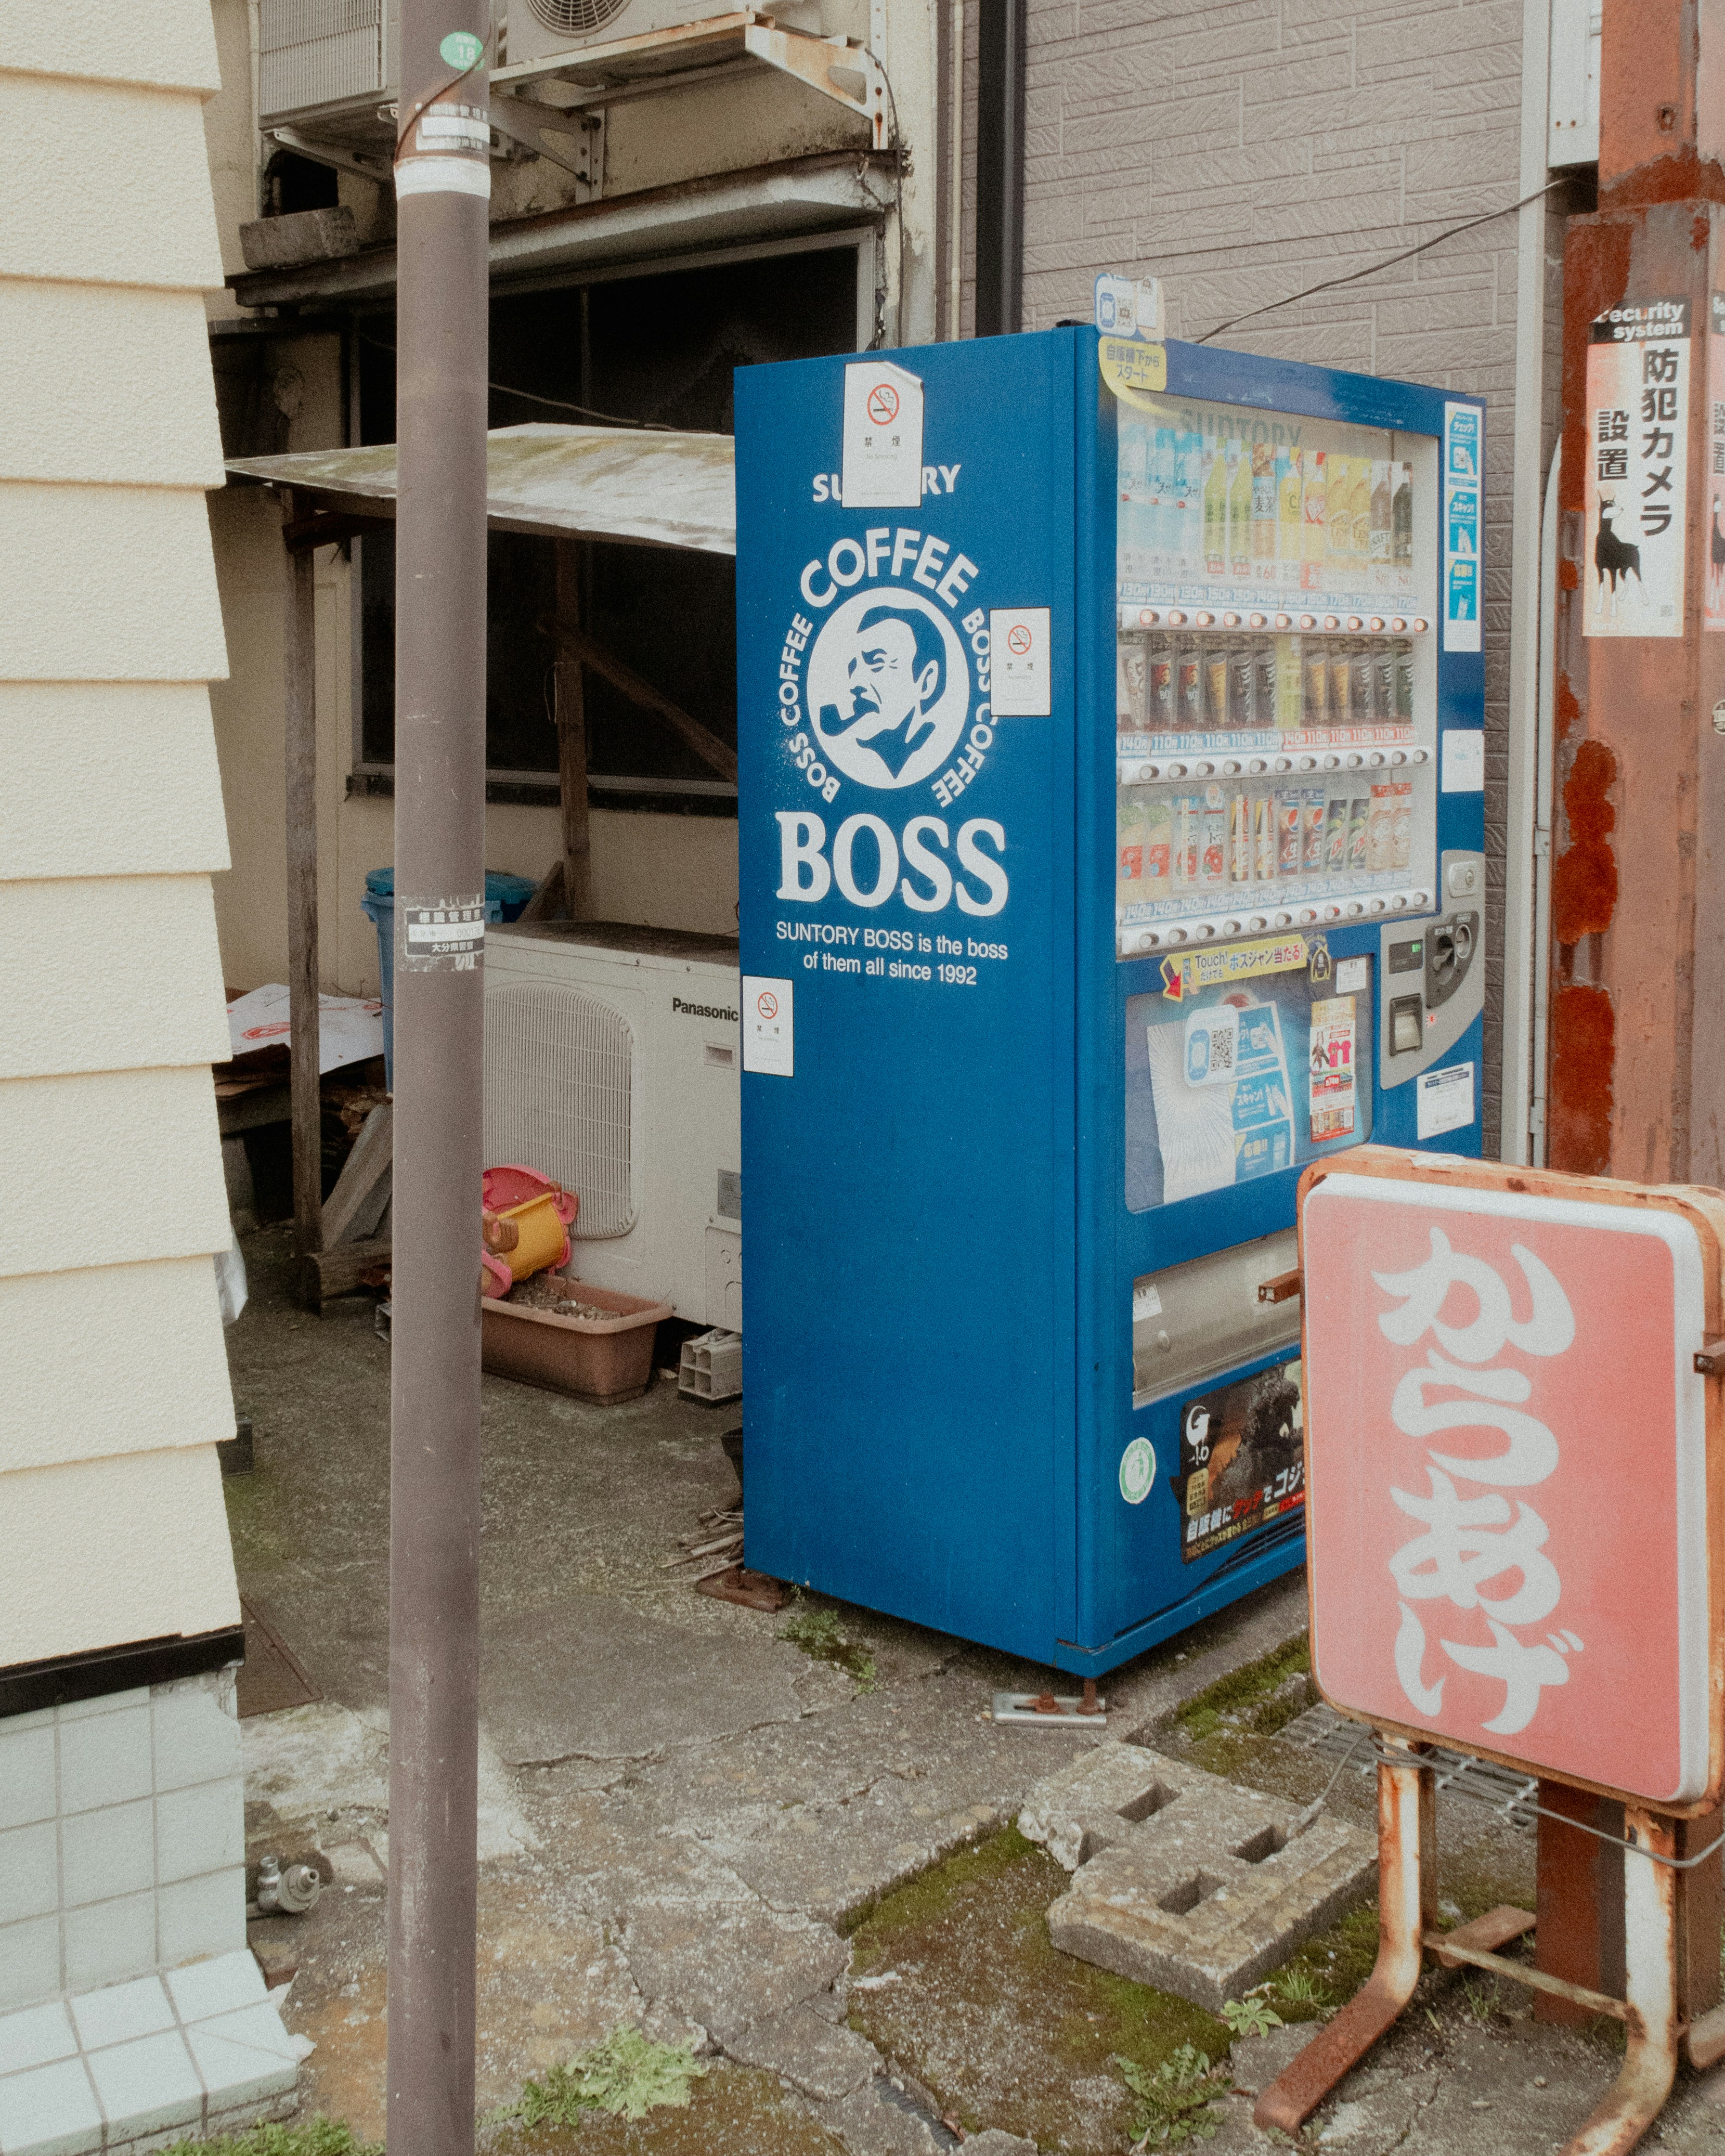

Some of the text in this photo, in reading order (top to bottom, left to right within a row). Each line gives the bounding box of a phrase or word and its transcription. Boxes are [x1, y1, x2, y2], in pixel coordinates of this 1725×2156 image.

[1594, 302, 1684, 325] ecurity
[1613, 320, 1683, 342] system
[865, 435, 901, 447] 禁煙
[1597, 409, 1630, 482] 設置
[1640, 347, 1679, 538] 防犯カメラ
[813, 464, 962, 502] SURY
[800, 527, 979, 608] COFFEE
[779, 613, 841, 803] BOSS COFFEE
[931, 608, 998, 809] BOSS COFFEE
[775, 811, 1009, 917] BOSS
[776, 921, 1008, 959] SUNTORY BOSS is the boss
[1196, 942, 1304, 971] Touch! ボスジャン当たる!
[804, 952, 977, 985] of them all since 1992
[672, 997, 738, 1022] Panasonic
[1371, 1225, 1585, 1735] からあげ
